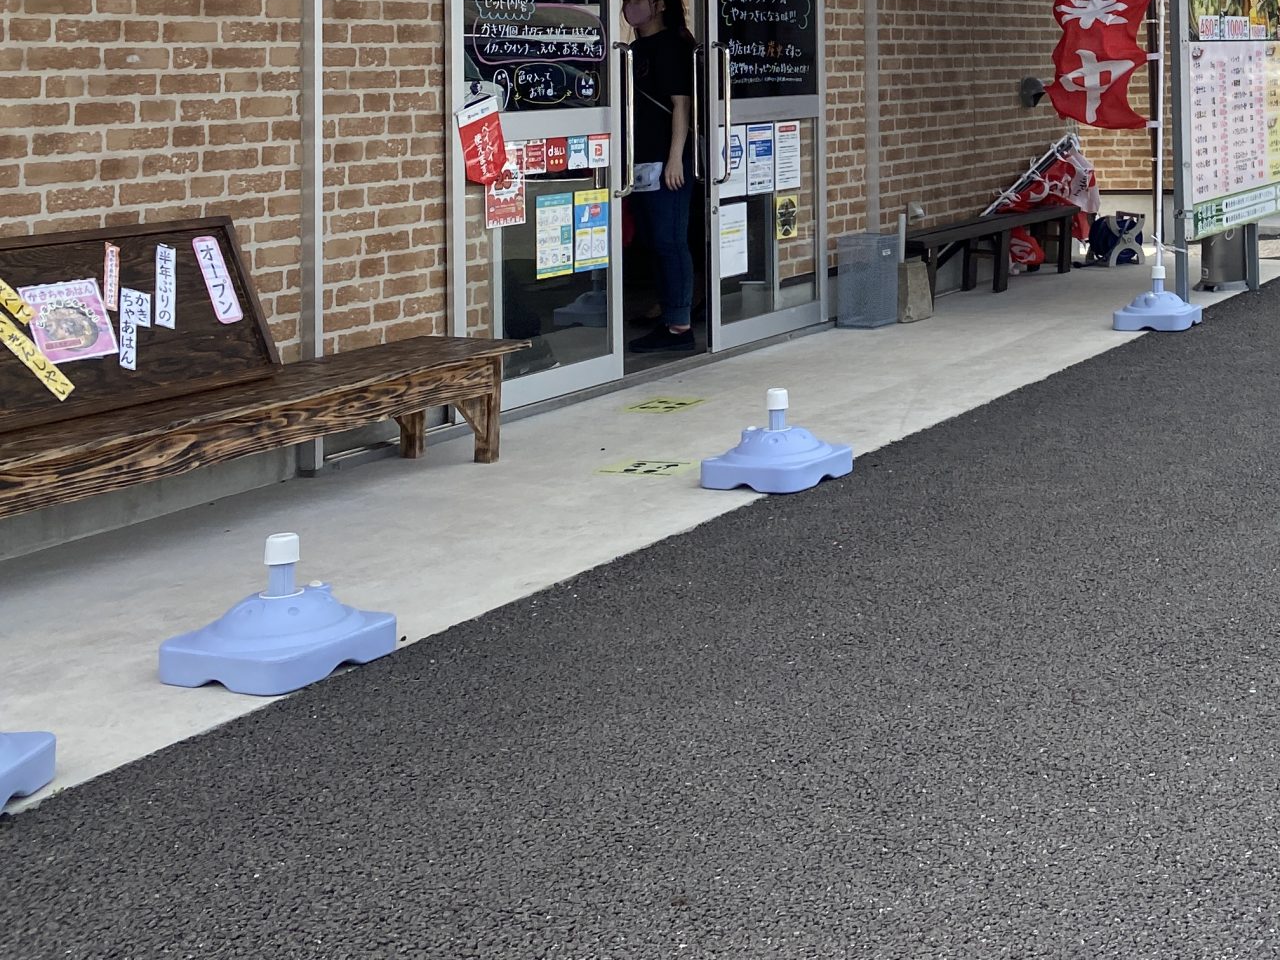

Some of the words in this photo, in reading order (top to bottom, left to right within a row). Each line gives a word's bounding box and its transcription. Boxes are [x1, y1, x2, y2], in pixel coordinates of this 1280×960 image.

[27, 284, 93, 303] かきちゃあはん
[135, 293, 149, 323] かき
[158, 249, 173, 323] 半年ぶりの
[199, 244, 233, 316] オープン
[121, 293, 135, 365] ちゃあはん
